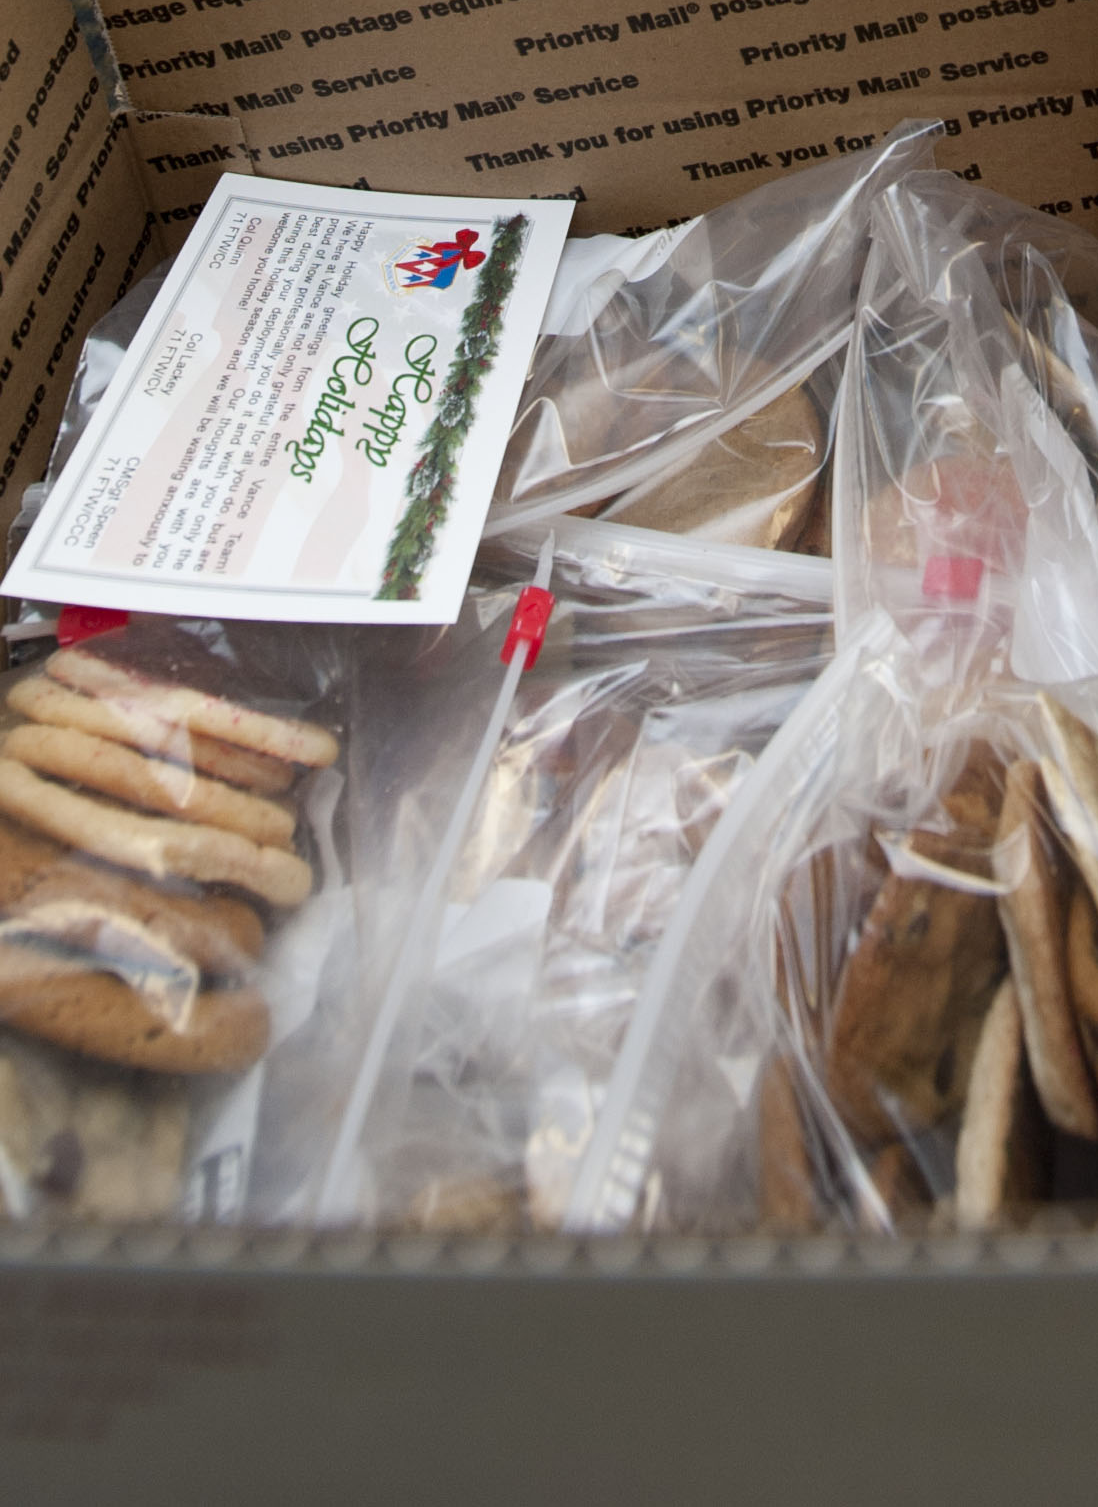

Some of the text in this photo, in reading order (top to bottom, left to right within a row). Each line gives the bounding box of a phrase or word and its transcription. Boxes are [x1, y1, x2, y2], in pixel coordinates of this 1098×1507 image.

[208, 212, 248, 270] 71 FTW/CC
[228, 216, 263, 265] Col Quinn
[238, 212, 292, 311] welcome you home!
[132, 214, 309, 567] during this holiday season and we will be waiting anxiously to
[143, 329, 187, 397] 71 FTW/CV
[152, 216, 326, 569] best during your deployment. Our thoughts are with you
[160, 333, 204, 396] Col Lackey
[172, 217, 340, 571] proud of how professionally you do it and wish you only the
[193, 220, 359, 572] We here at Vance are not only grateful for all you do, but are
[215, 221, 375, 574] Happy Holiday greetings from the entire Vance Team!
[285, 317, 379, 483] Holidays
[356, 333, 438, 468] Happy
[64, 458, 121, 546] 71 FTW/CCC
[84, 456, 141, 549] CMSgt Speen
